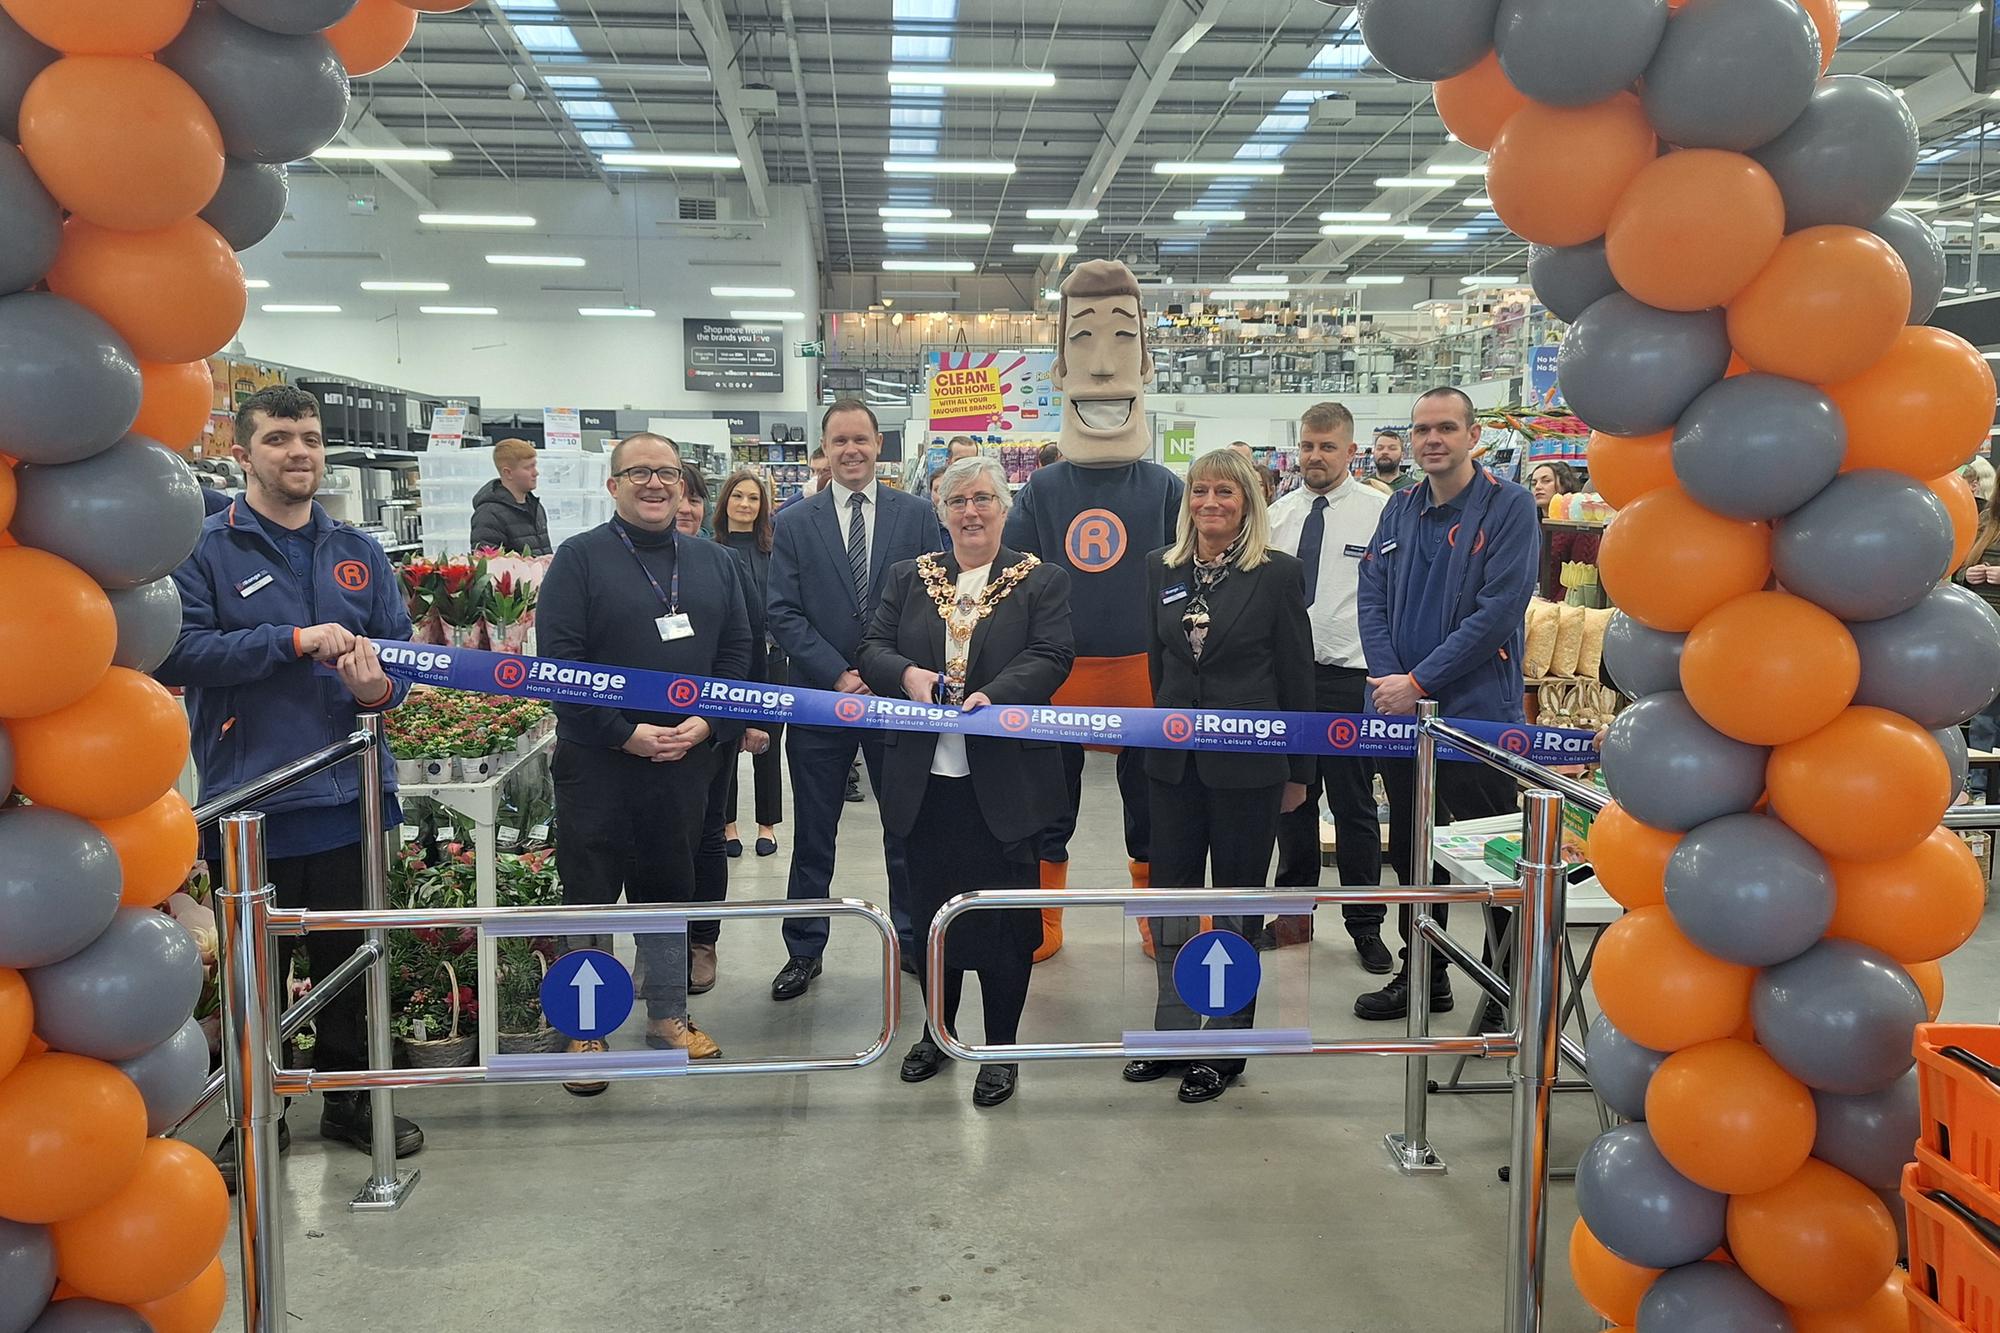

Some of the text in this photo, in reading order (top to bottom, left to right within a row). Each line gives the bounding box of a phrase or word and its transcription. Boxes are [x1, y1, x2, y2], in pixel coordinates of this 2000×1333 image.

[703, 325, 723, 334] Shop
[745, 326, 763, 334] from
[711, 334, 737, 342] brands
[936, 370, 988, 387] CLEAN
[934, 384, 996, 397] YOUR HOME
[585, 417, 600, 425] Pets
[418, 671, 449, 681] Garden
[528, 661, 539, 678] The
[538, 662, 626, 689] Range
[526, 684, 624, 701] Home Leisure Garden
[701, 682, 711, 697] The
[710, 682, 795, 707] Range
[699, 703, 793, 717] Home Leisure Garden
[868, 700, 877, 713] The
[877, 700, 959, 720] Range
[895, 718, 924, 726] Leisure
[929, 720, 959, 728] Garden
[1031, 707, 1040, 722] The
[1040, 708, 1122, 729] Range
[1195, 714, 1204, 731] The
[1204, 714, 1287, 736] Range
[1360, 719, 1368, 737] The
[1369, 719, 1418, 739] Ran
[1031, 727, 1054, 735] Home
[1093, 731, 1122, 740] Garden
[1195, 737, 1287, 747] Home Leisure Garden
[1359, 742, 1383, 750] Home
[1534, 731, 1542, 748] The
[1543, 732, 1595, 751] Ran
[1532, 753, 1595, 763] Home Leisure
